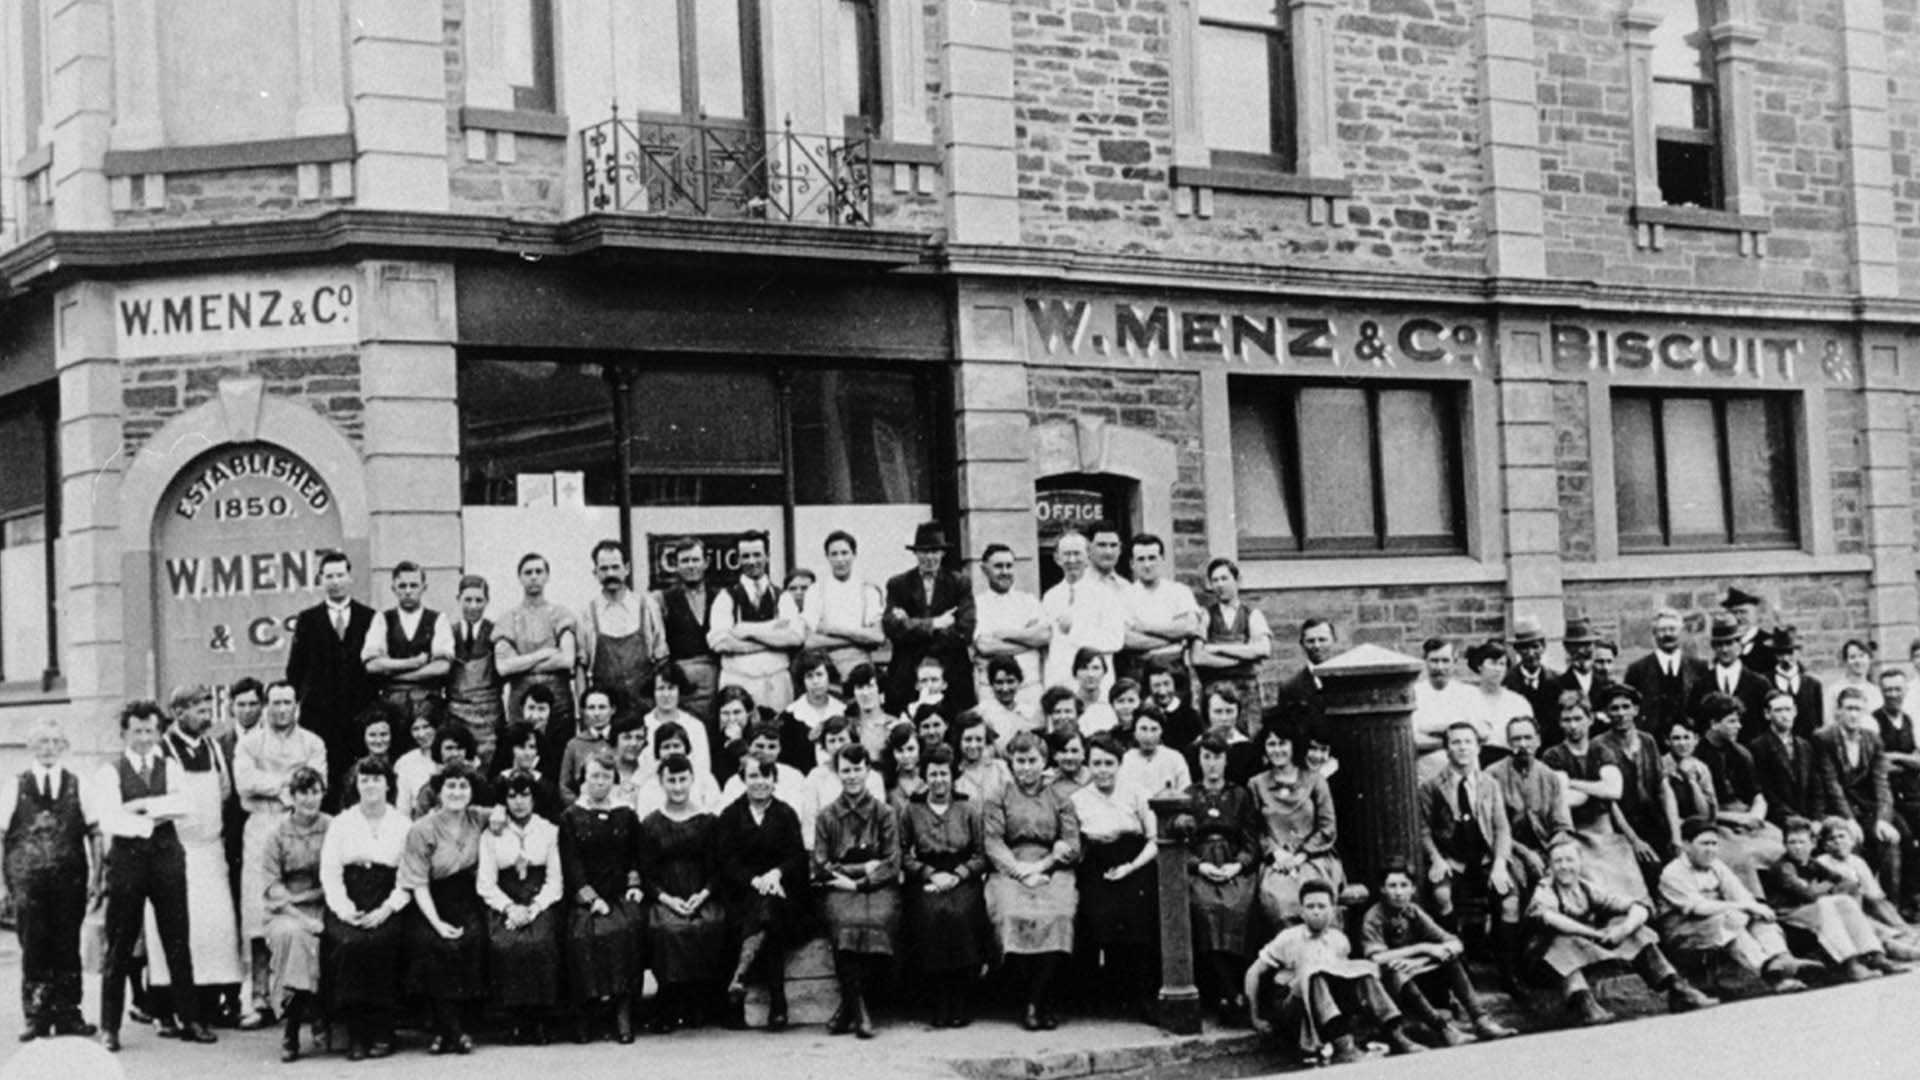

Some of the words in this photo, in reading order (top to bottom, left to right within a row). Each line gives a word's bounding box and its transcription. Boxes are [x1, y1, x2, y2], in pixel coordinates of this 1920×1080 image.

[288, 299, 307, 326] &
[1354, 319, 1394, 367] &
[1550, 322, 1803, 381] BISCUIT
[175, 453, 330, 520] ESTABLISHED
[1036, 500, 1104, 521] OFFICE
[210, 614, 236, 653] &
